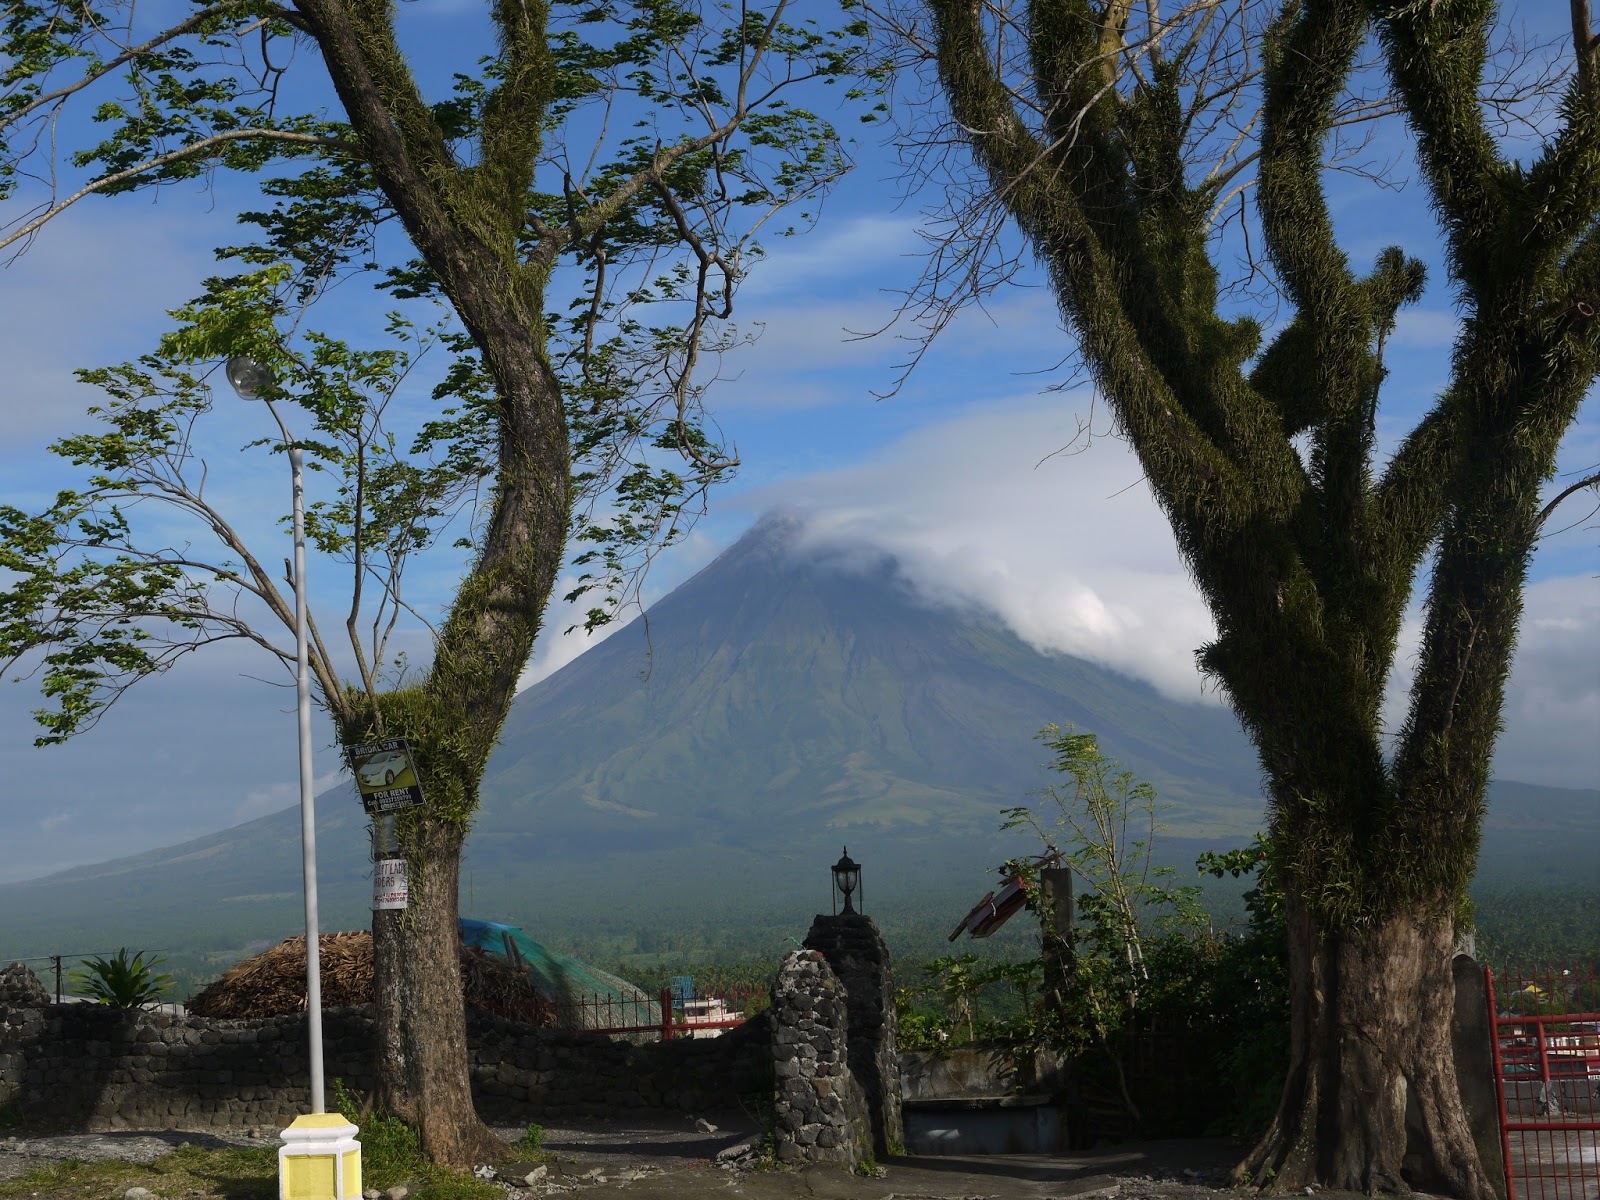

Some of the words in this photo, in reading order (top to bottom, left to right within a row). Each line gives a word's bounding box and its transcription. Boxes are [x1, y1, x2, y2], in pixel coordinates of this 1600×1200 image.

[354, 744, 381, 756] BRIDAL
[383, 741, 399, 751] CAR
[373, 790, 389, 800] FOR
[389, 787, 409, 797] RENT
